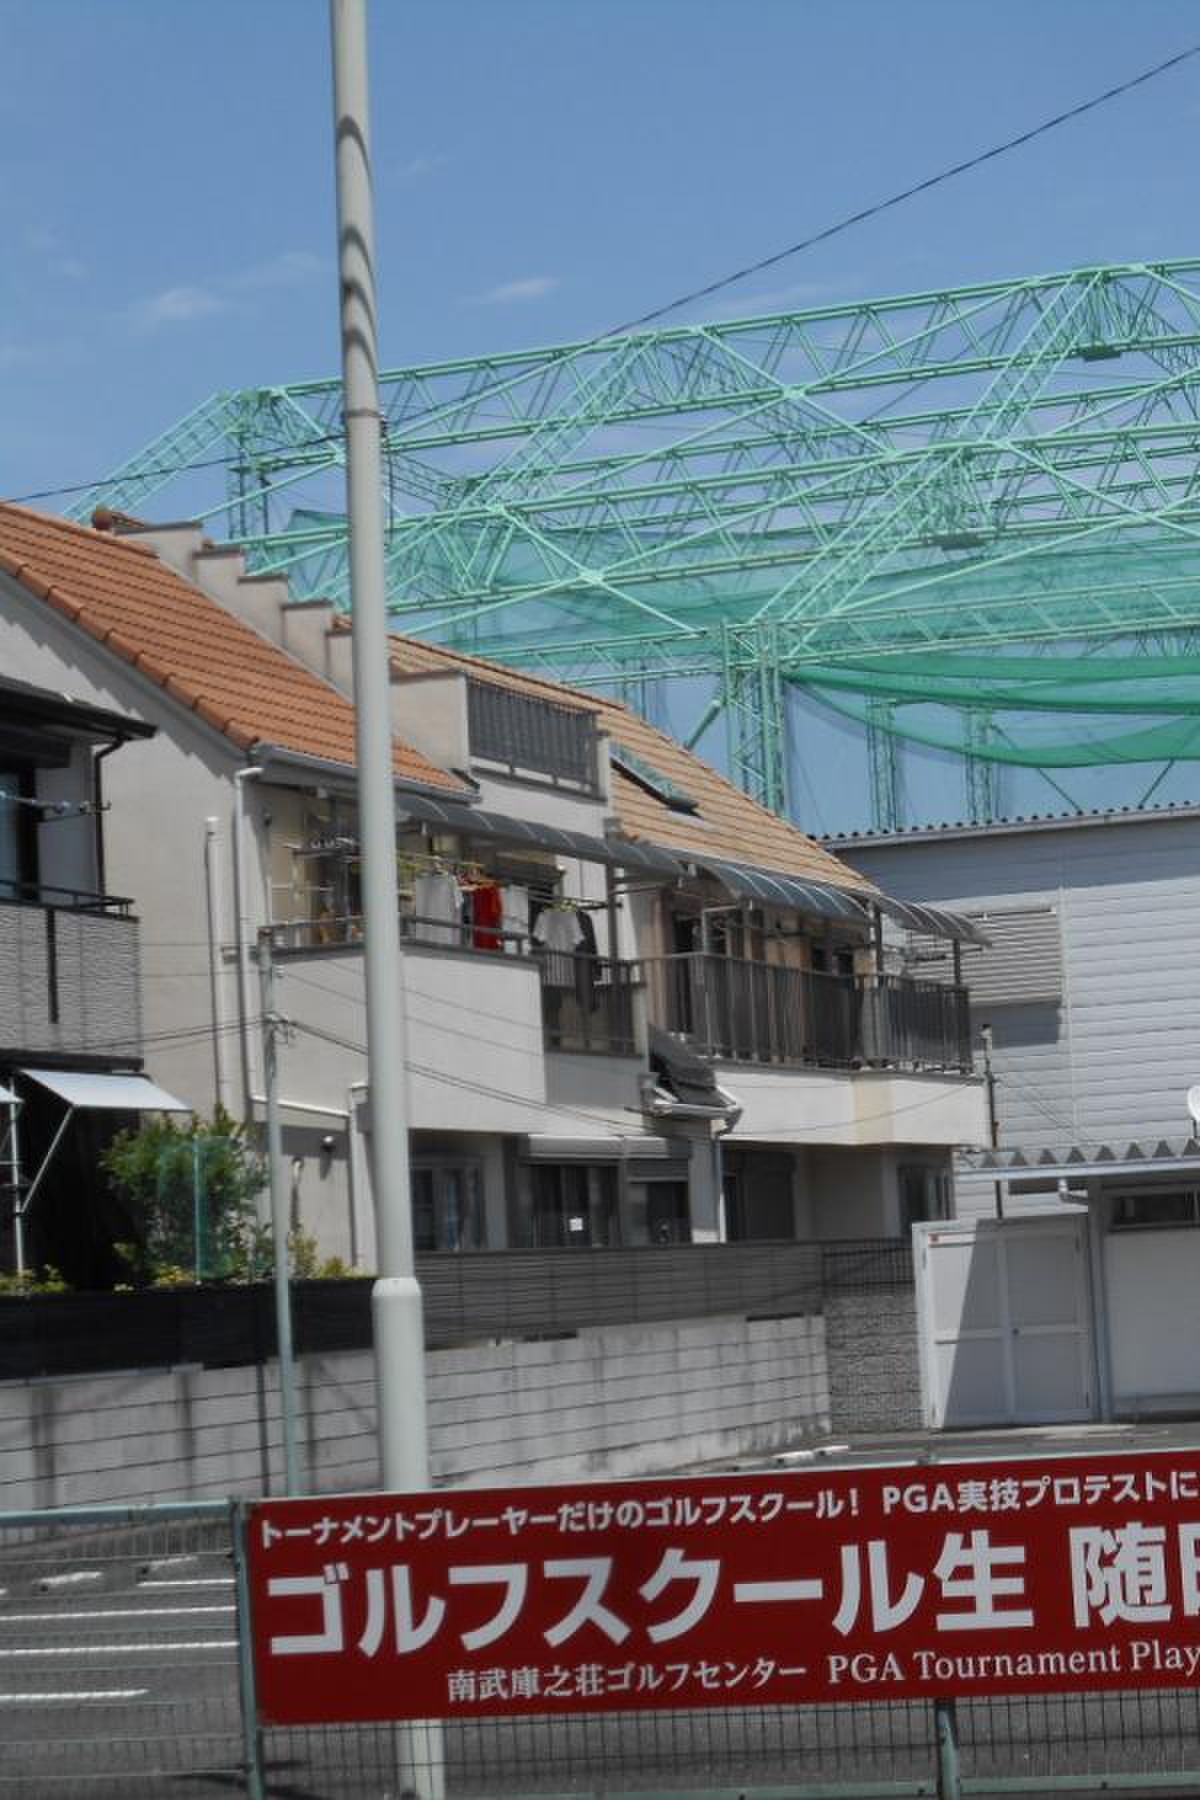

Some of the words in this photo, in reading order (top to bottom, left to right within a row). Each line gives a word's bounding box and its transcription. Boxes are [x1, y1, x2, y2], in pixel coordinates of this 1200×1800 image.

[267, 1528, 1034, 1656] ゴルフスクール生
[447, 1657, 807, 1702] 南武庫之荘ゴルフセンター
[827, 1652, 905, 1684] PGA
[912, 1643, 1121, 1681] Tournament
